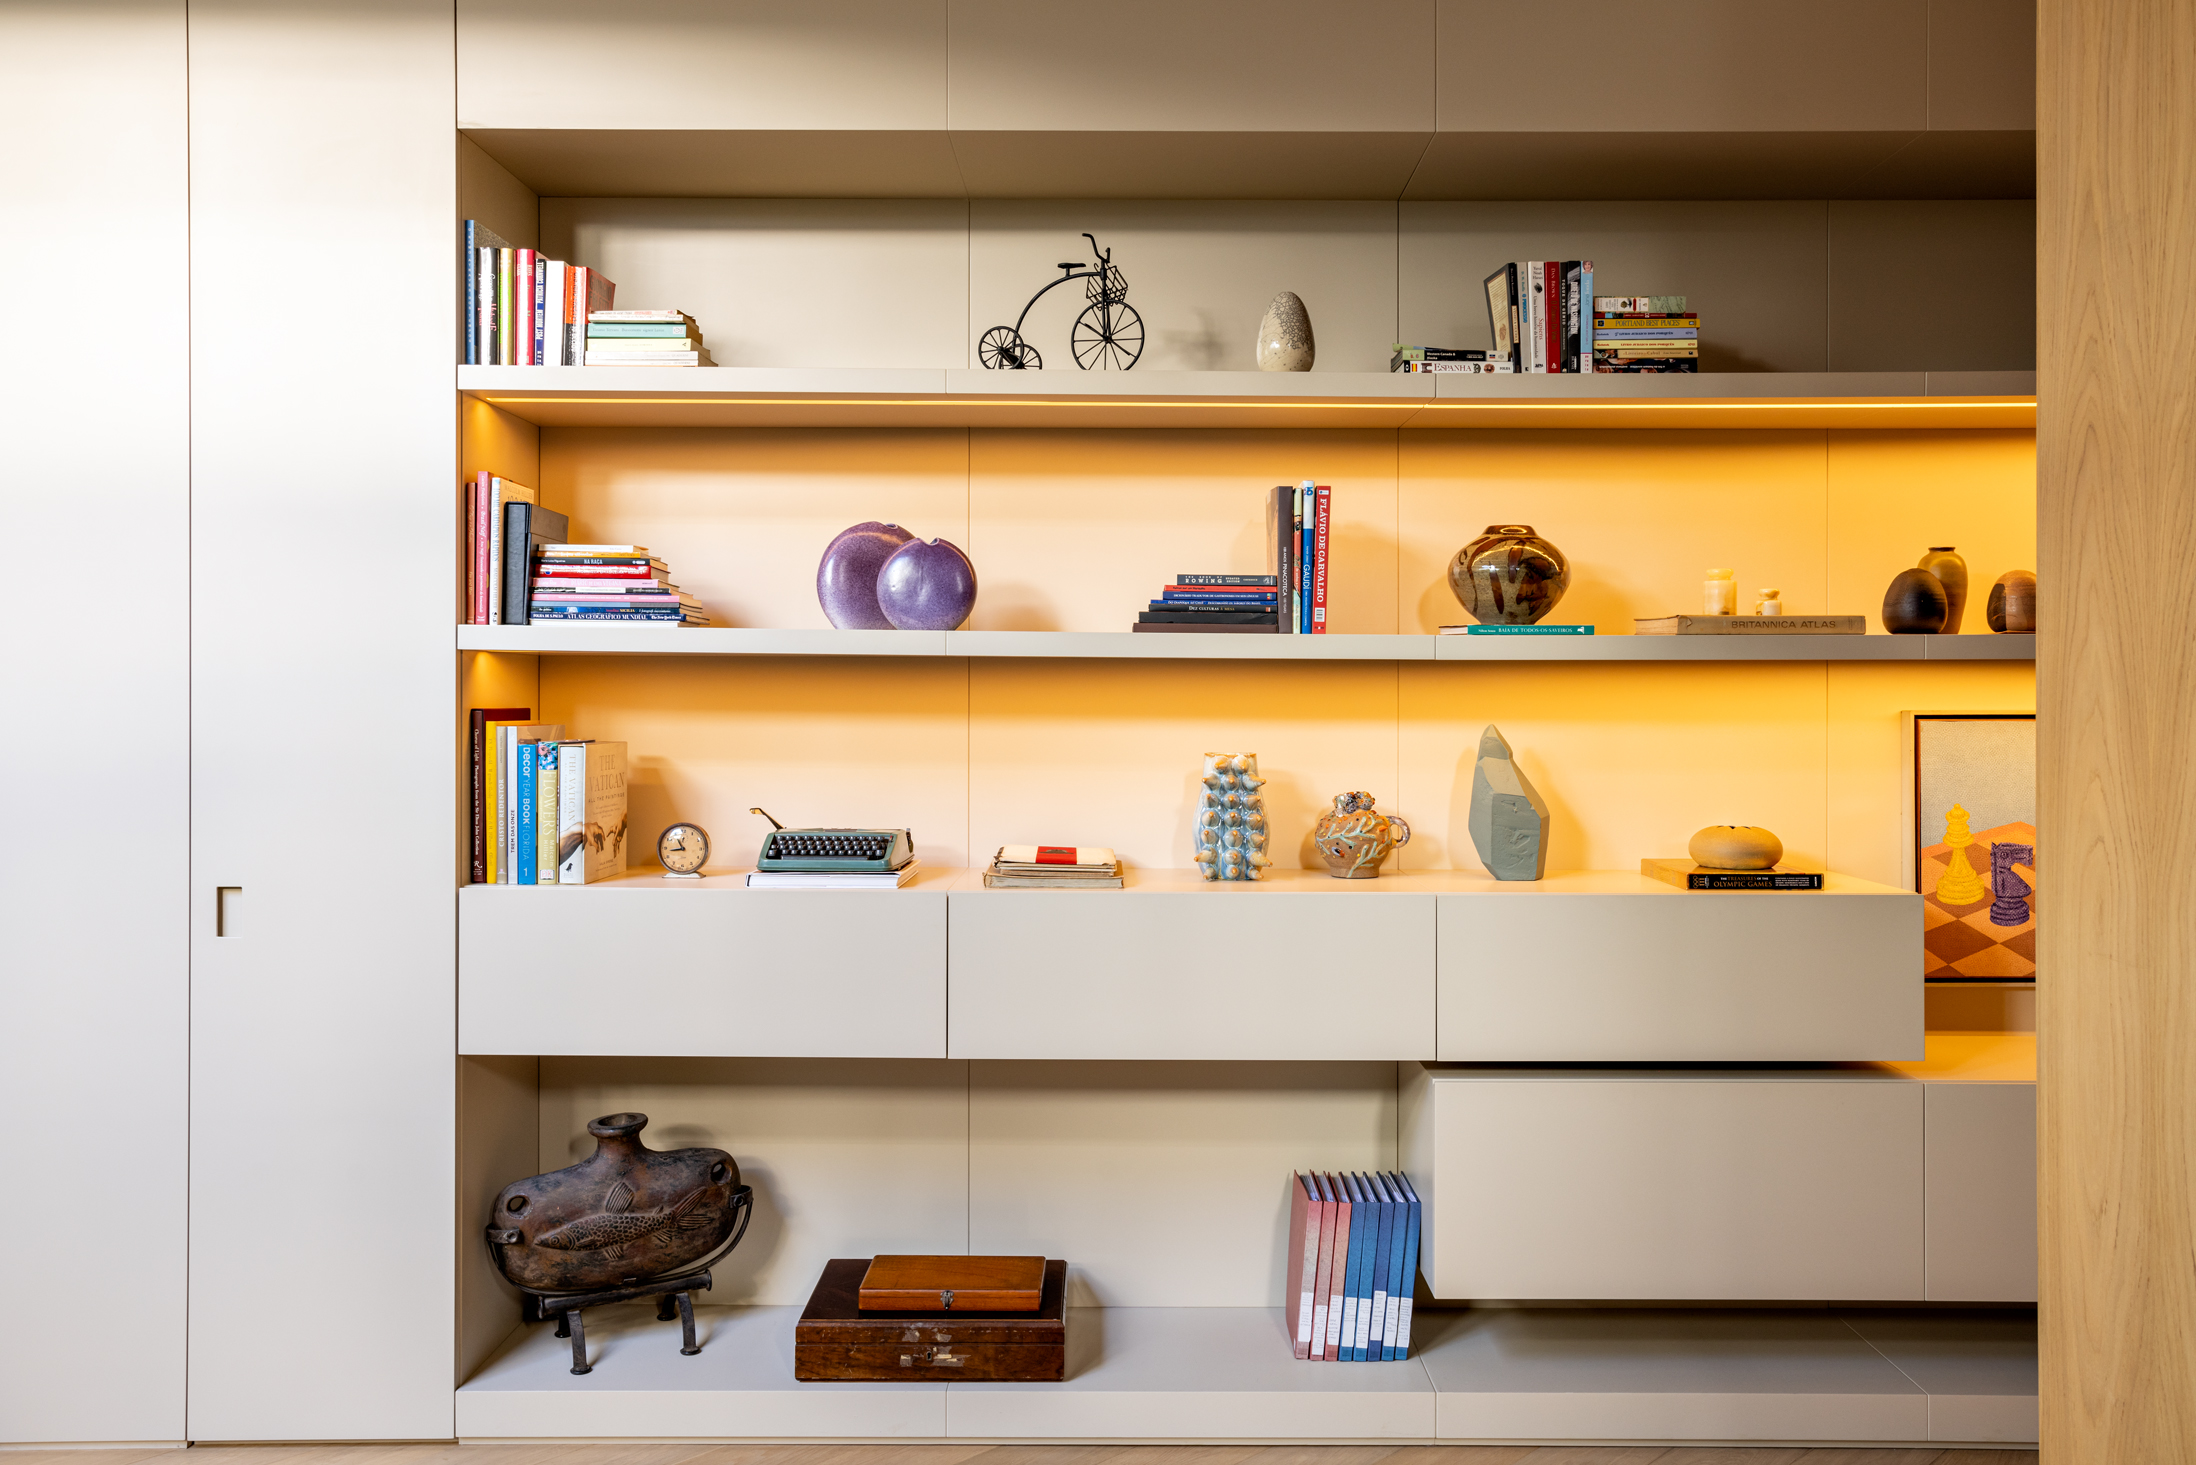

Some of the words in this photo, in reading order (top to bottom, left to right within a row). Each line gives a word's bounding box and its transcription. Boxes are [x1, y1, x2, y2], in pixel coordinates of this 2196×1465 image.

[1433, 363, 1473, 372] ESPANHA
[1318, 498, 1328, 534] FLÁVIO
[1318, 535, 1326, 549] DE
[1303, 564, 1312, 590] GAUDÍ
[1316, 550, 1326, 602] CARVALHO
[585, 612, 621, 620] GEOGRÁFICO
[1731, 621, 1797, 629] BRITANNICA
[1799, 621, 1836, 629] ATLAS
[568, 754, 577, 776] THE
[599, 754, 616, 772] THE
[589, 772, 625, 792] VATICAN
[543, 771, 557, 836] FLOWERS
[568, 778, 577, 821] VATICAN
[522, 825, 531, 861] FLORIDA
